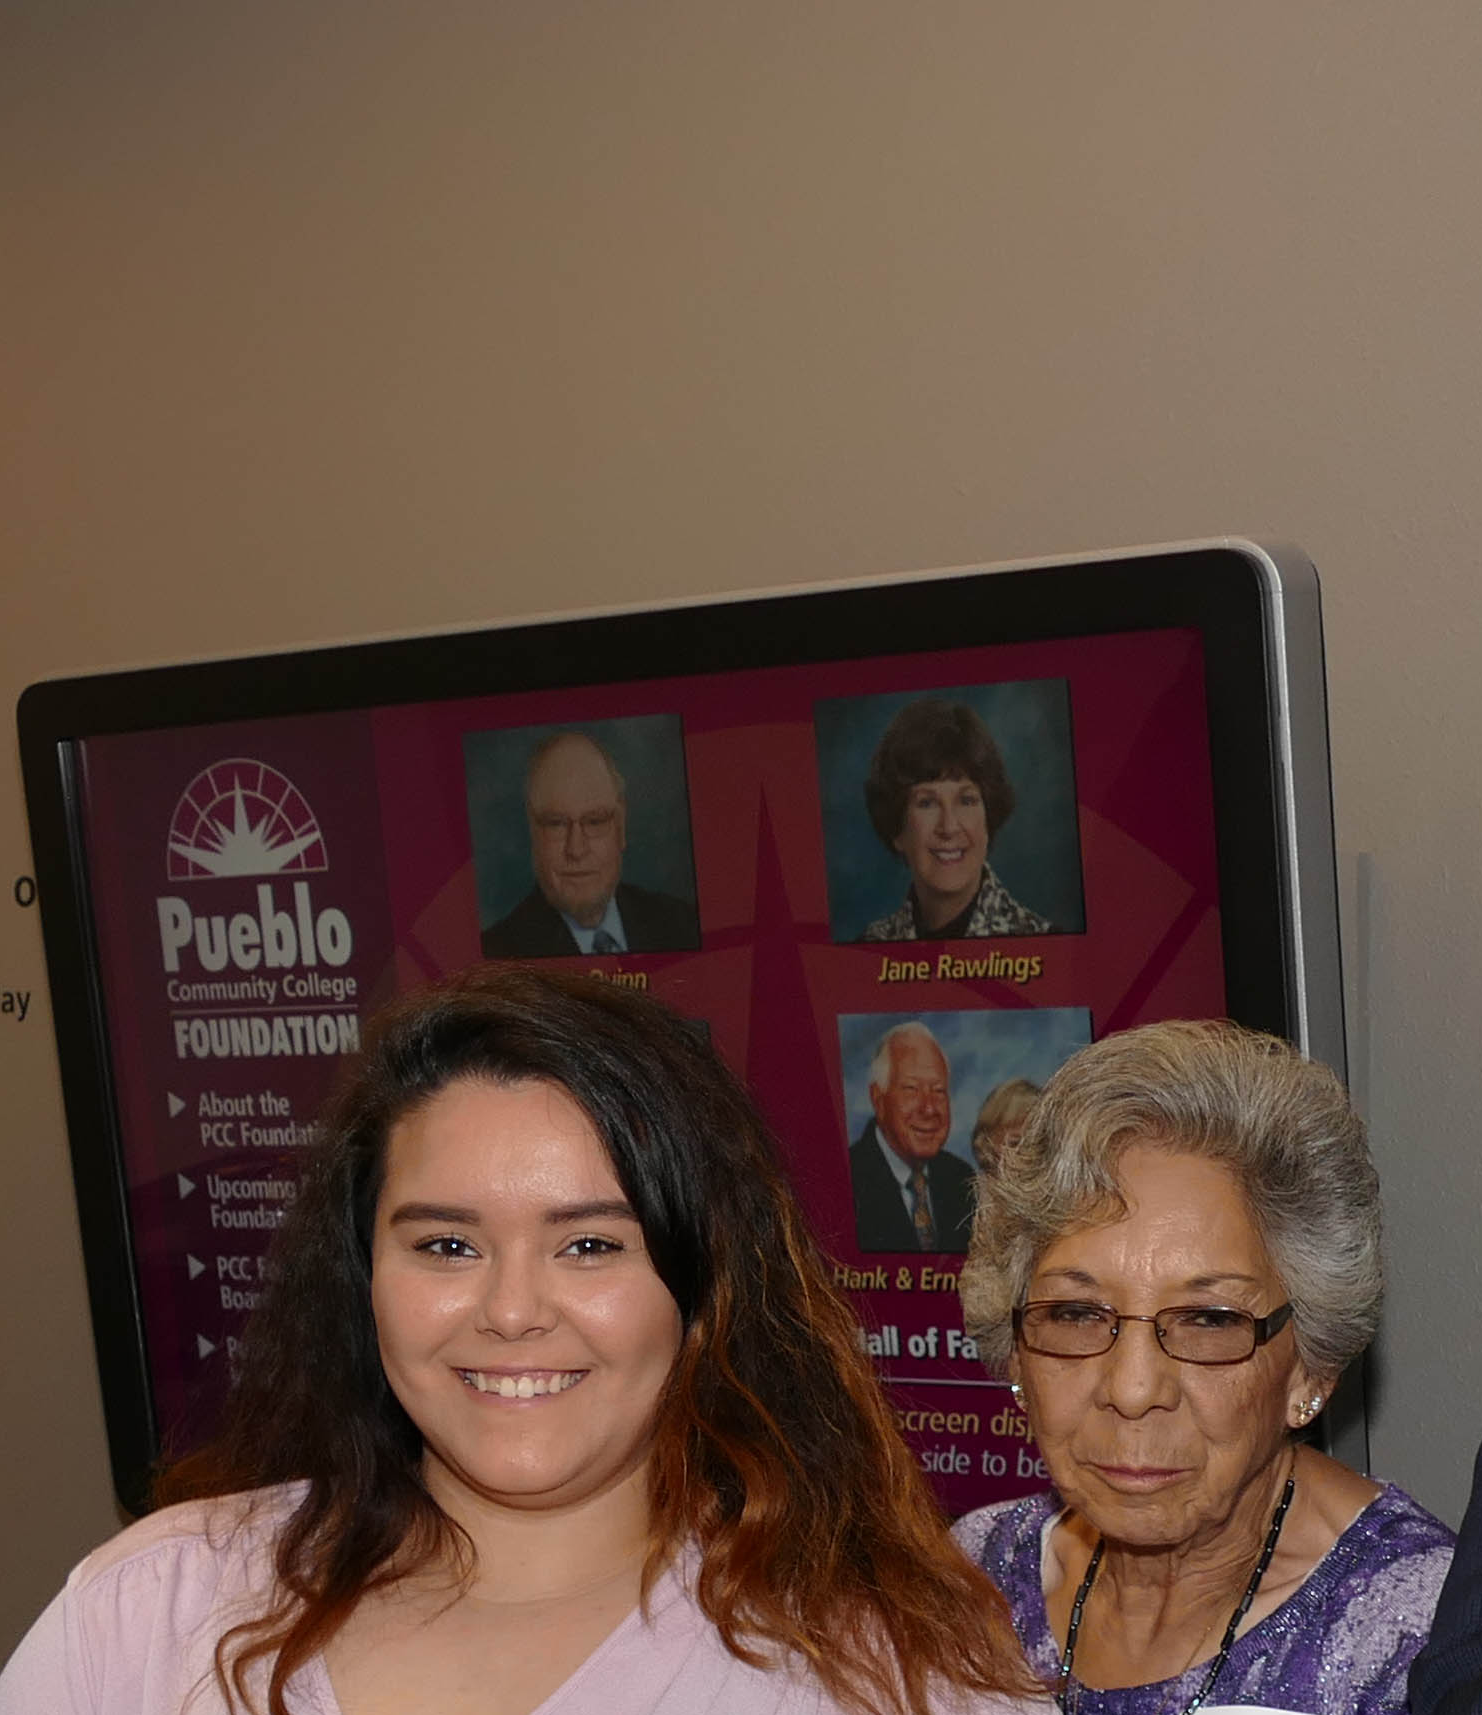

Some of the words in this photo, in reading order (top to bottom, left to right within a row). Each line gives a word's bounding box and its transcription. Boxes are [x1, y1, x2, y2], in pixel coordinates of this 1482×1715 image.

[14, 875, 36, 907] o
[157, 881, 353, 973] Pueblo
[877, 955, 930, 983] Jane
[937, 951, 1042, 982] Rawlings
[167, 974, 277, 1004] Community
[283, 973, 357, 1000] College
[173, 1014, 361, 1059] FOUNDATION
[199, 1092, 255, 1117] About
[260, 1090, 290, 1116] the
[200, 1123, 236, 1148] PCC
[206, 1174, 296, 1206] Upcoming
[217, 1256, 252, 1280] PCC
[833, 1266, 887, 1289] Hank
[895, 1267, 913, 1289] &
[908, 1328, 939, 1358] of
[921, 1445, 969, 1473] side
[982, 1449, 1006, 1477] to
